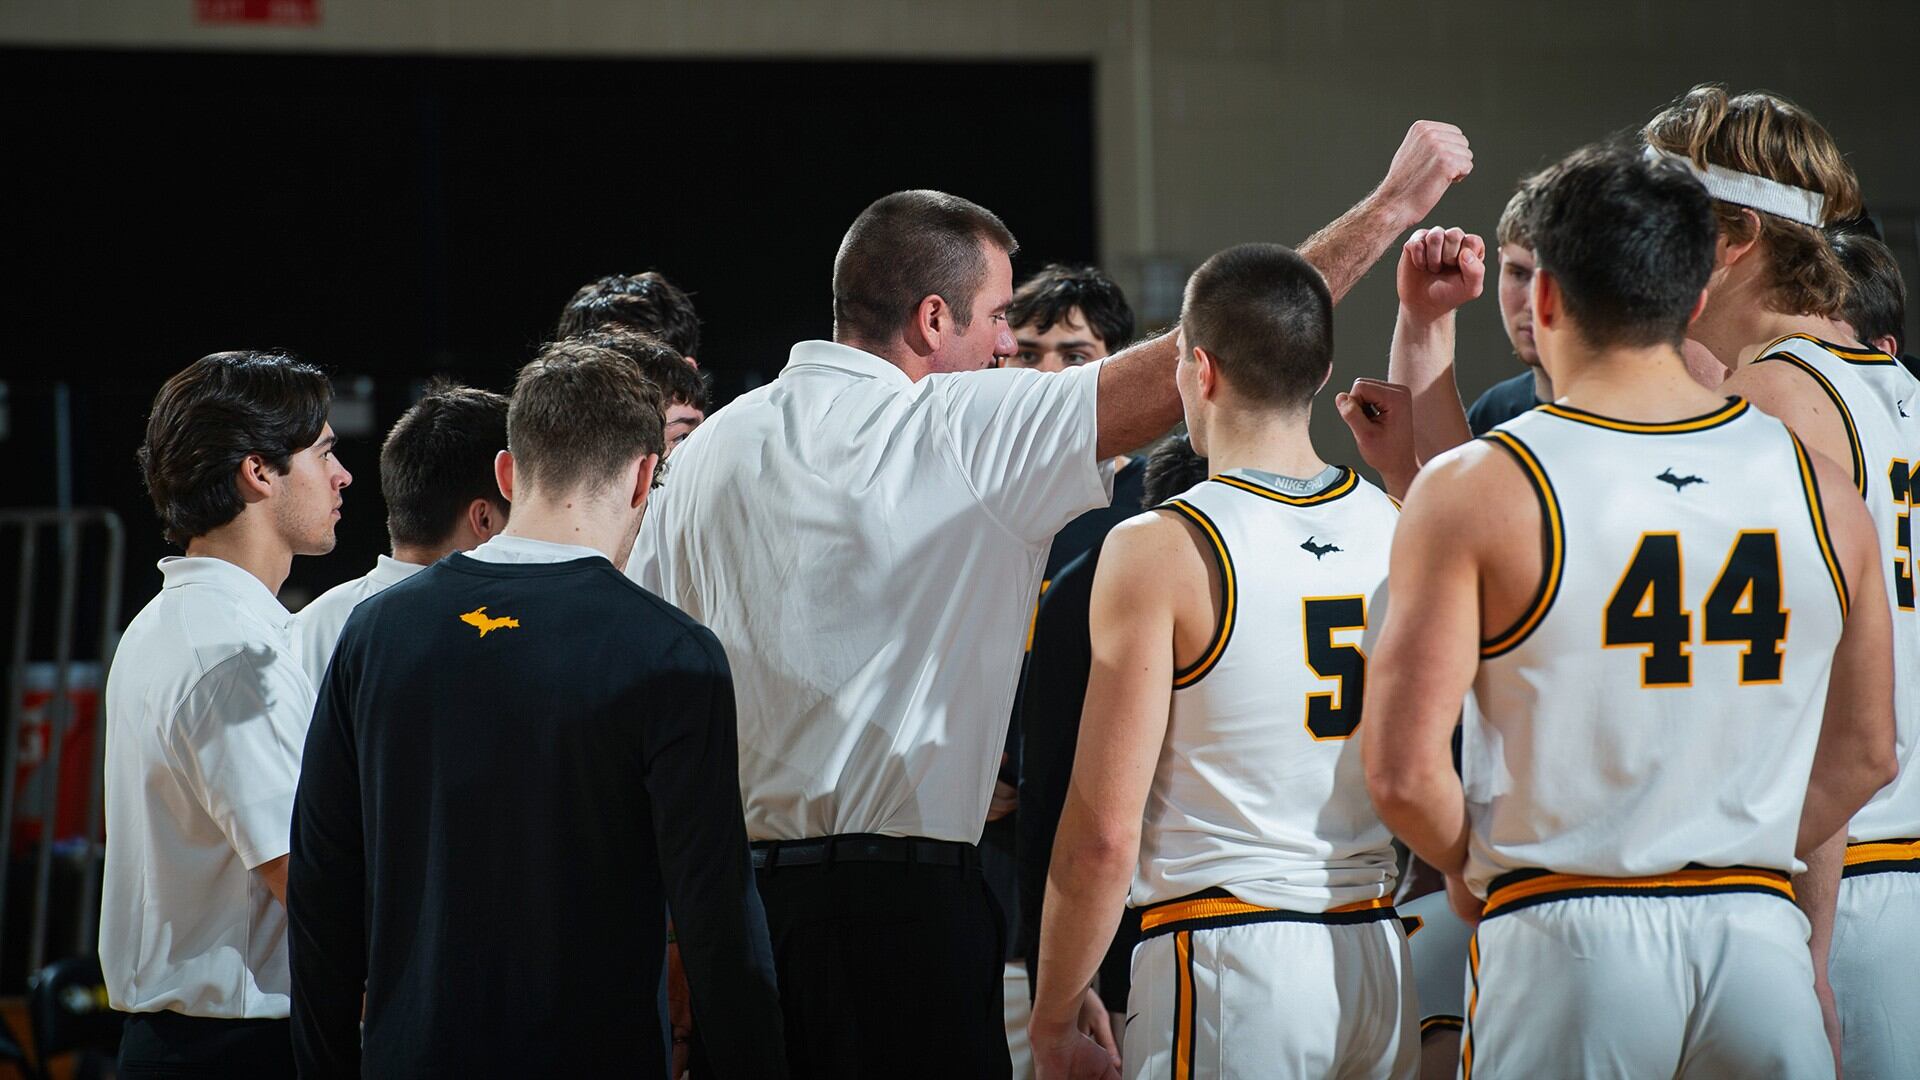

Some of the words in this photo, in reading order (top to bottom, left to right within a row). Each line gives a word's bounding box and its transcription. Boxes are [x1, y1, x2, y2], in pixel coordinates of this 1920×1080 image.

[1274, 476, 1306, 491] NIKE
[1302, 595, 1367, 741] 5
[1602, 529, 1791, 688] 44
